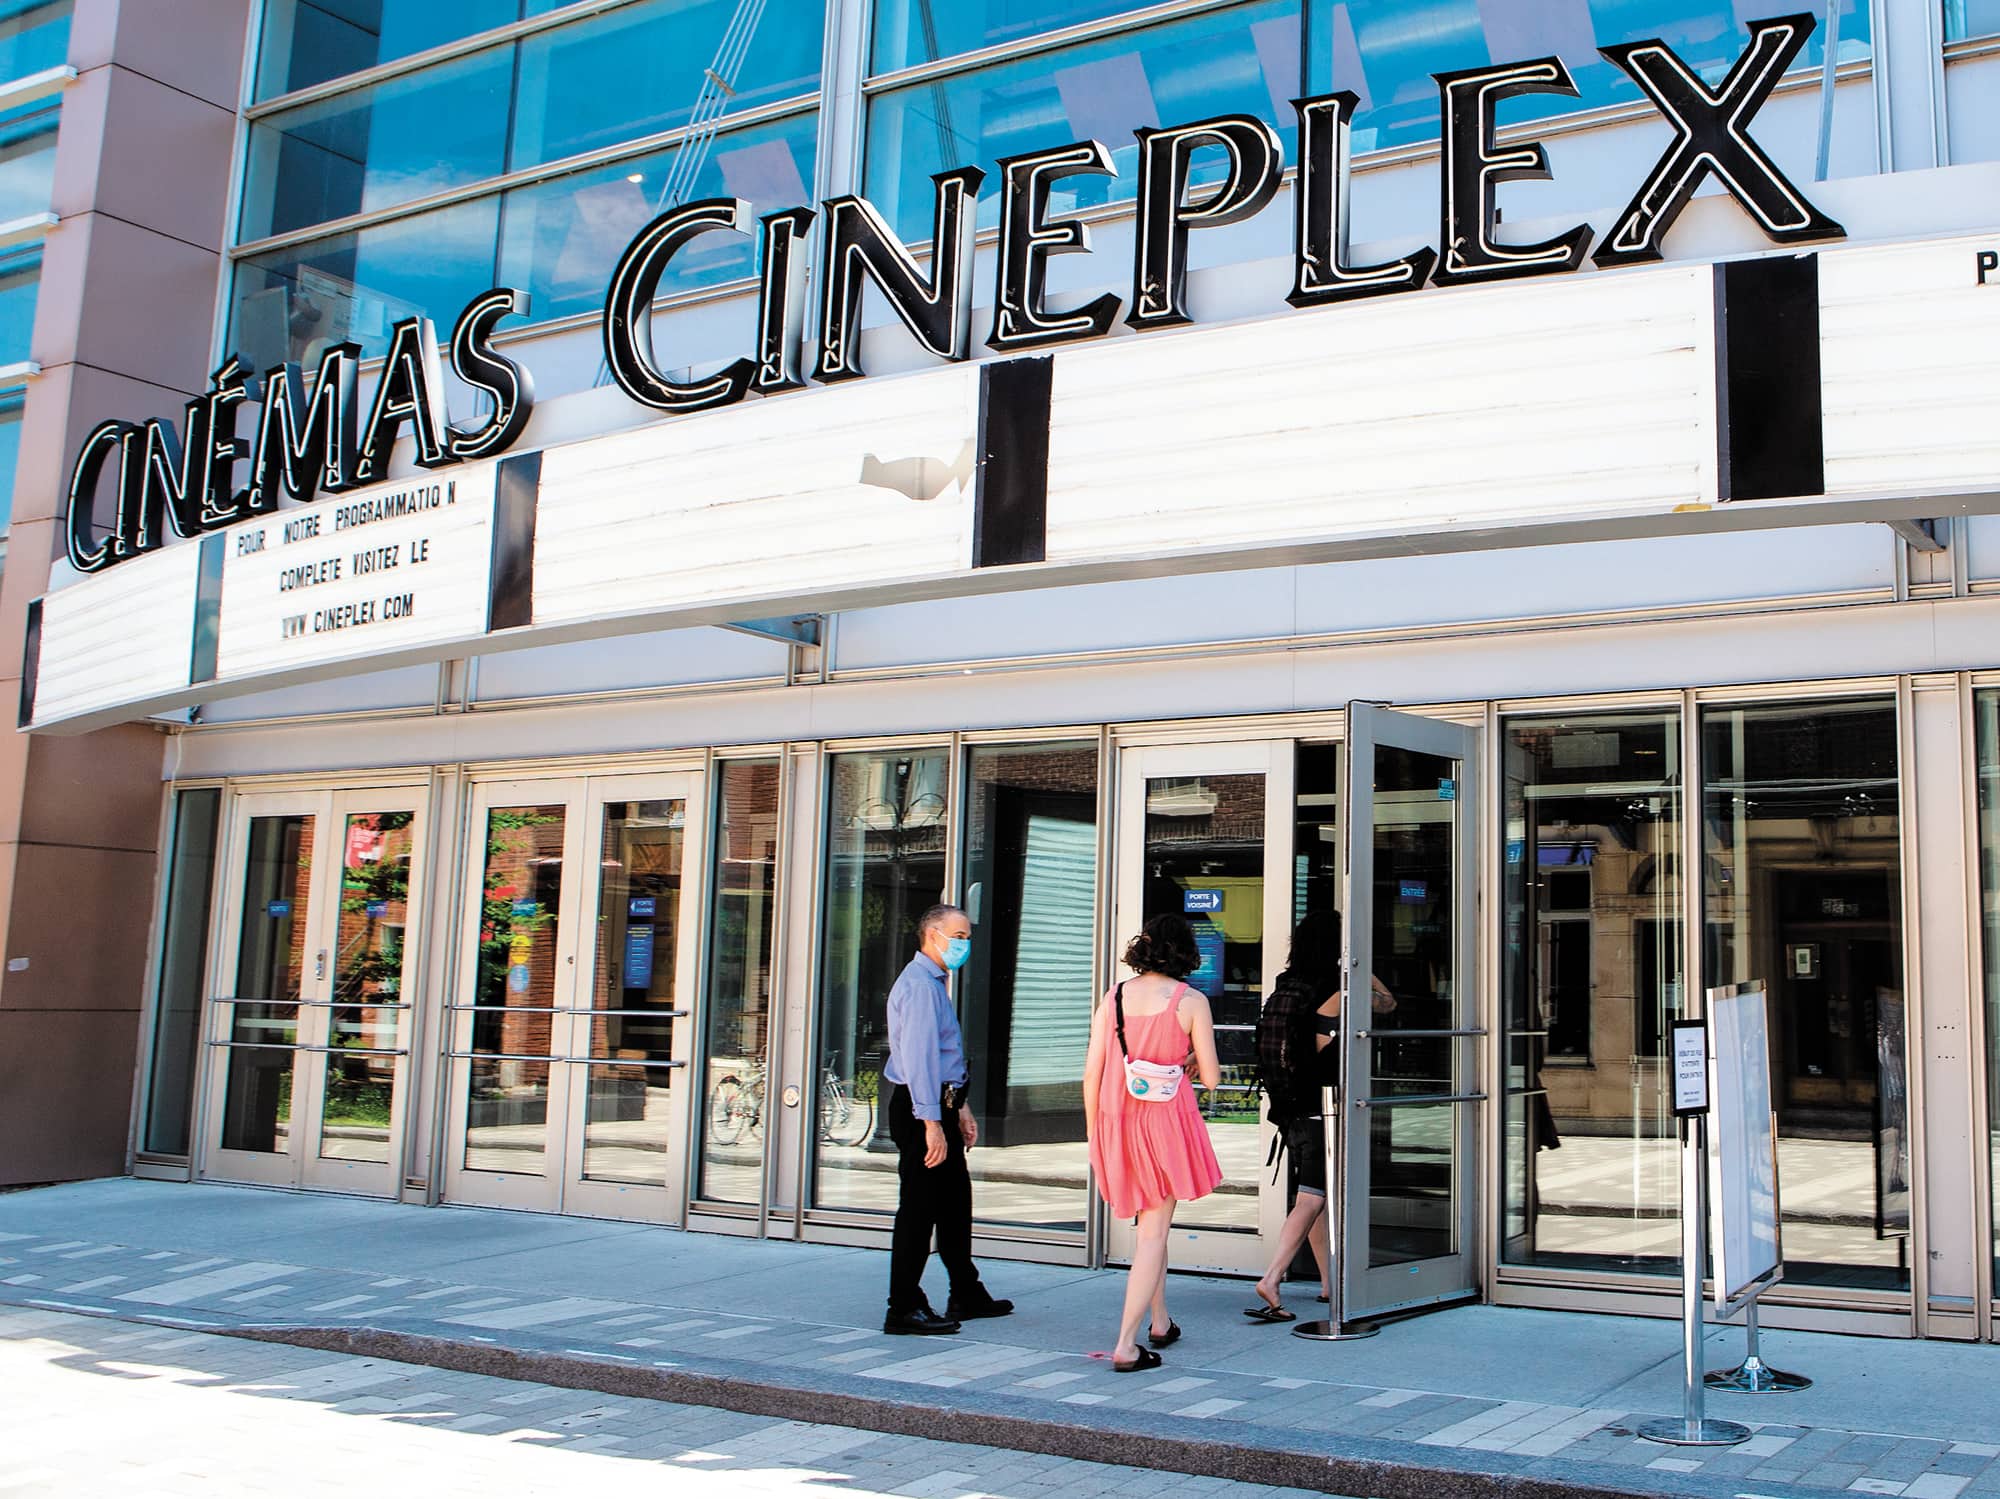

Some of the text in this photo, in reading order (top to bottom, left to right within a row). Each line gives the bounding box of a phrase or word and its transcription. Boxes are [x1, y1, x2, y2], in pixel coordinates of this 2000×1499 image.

[65, 12, 1847, 574] CINÉMAS CINEPLEX
[238, 530, 266, 557] POUR
[284, 515, 321, 544] NOTRE
[280, 539, 429, 592] COMPLETE VISITEZ LE
[314, 600, 377, 633] CINEPLEX
[383, 593, 415, 620] COM
